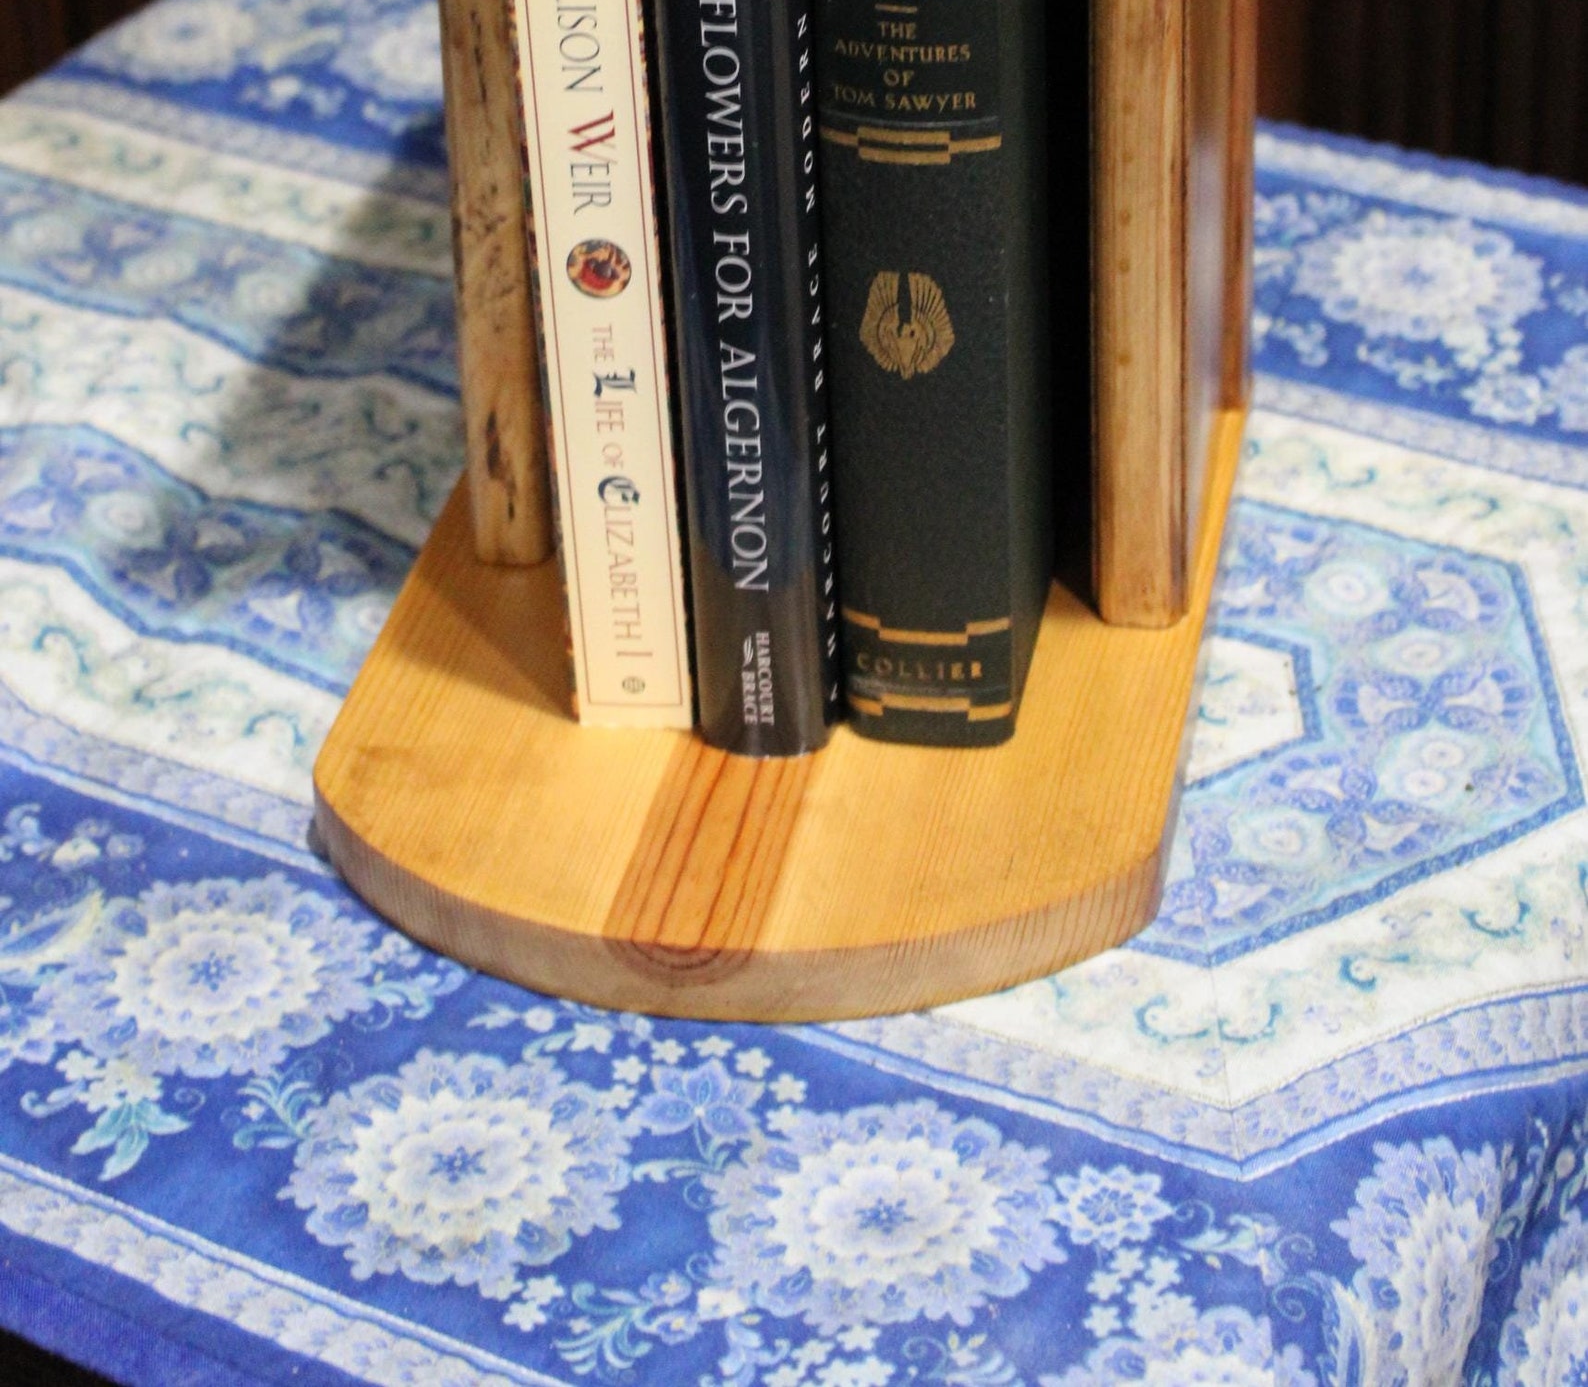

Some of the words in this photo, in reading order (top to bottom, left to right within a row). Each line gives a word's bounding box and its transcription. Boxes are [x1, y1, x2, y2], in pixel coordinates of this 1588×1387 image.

[835, 38, 972, 63] ADVENTURES
[878, 22, 918, 40] THE
[832, 84, 877, 106] TOM
[884, 91, 977, 113] SAWYER
[882, 69, 915, 87] OF
[797, 13, 816, 213] MODERN
[567, 110, 617, 215] WEIR
[713, 229, 753, 323] FOR
[808, 243, 824, 392] BRACE
[592, 324, 614, 361] THE
[602, 442, 624, 468] OF
[720, 339, 769, 592] ALGERNON
[598, 475, 642, 641] ELIZABETH
[616, 650, 653, 659] I
[857, 652, 982, 681] COLLIER
[741, 671, 758, 725] BRACE
[755, 631, 775, 726] HARCOURT
